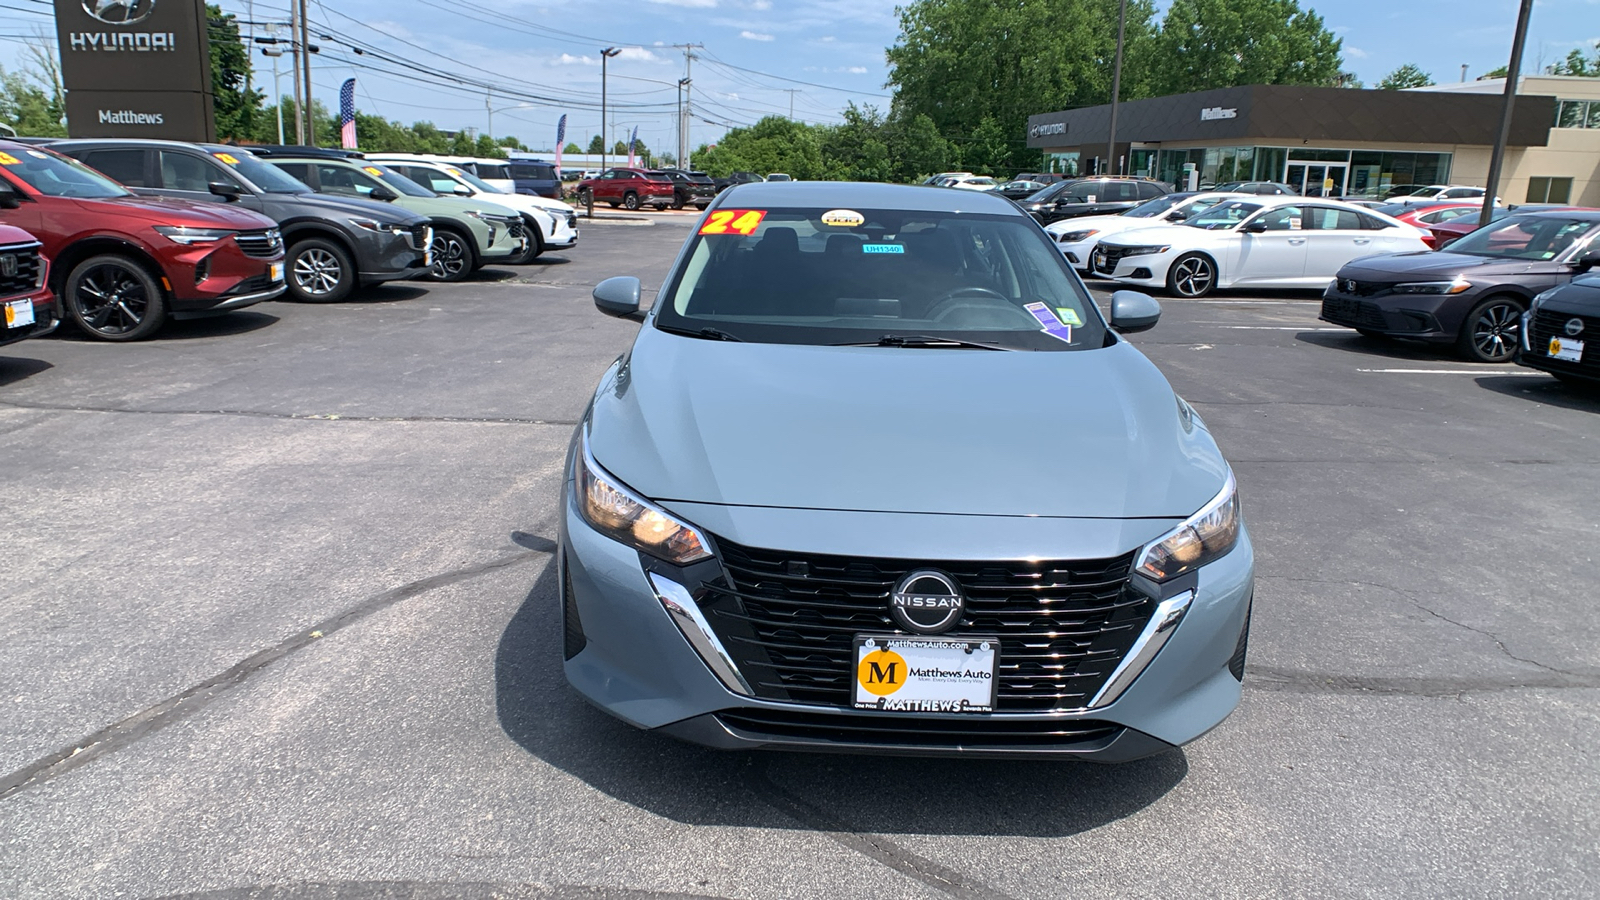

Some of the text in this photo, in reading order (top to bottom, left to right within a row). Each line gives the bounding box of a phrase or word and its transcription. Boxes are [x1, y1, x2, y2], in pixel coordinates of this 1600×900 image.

[70, 32, 175, 52] HYUNDAI
[98, 109, 164, 125] Matthews
[1040, 123, 1067, 135] HYUNDAI
[701, 210, 762, 234] 24
[893, 595, 962, 608] NISSAN
[887, 640, 969, 650] MatthewsAuto.com
[866, 661, 899, 685] M
[909, 667, 992, 680] Matthews Auto
[882, 700, 961, 712] MATTHEWS
